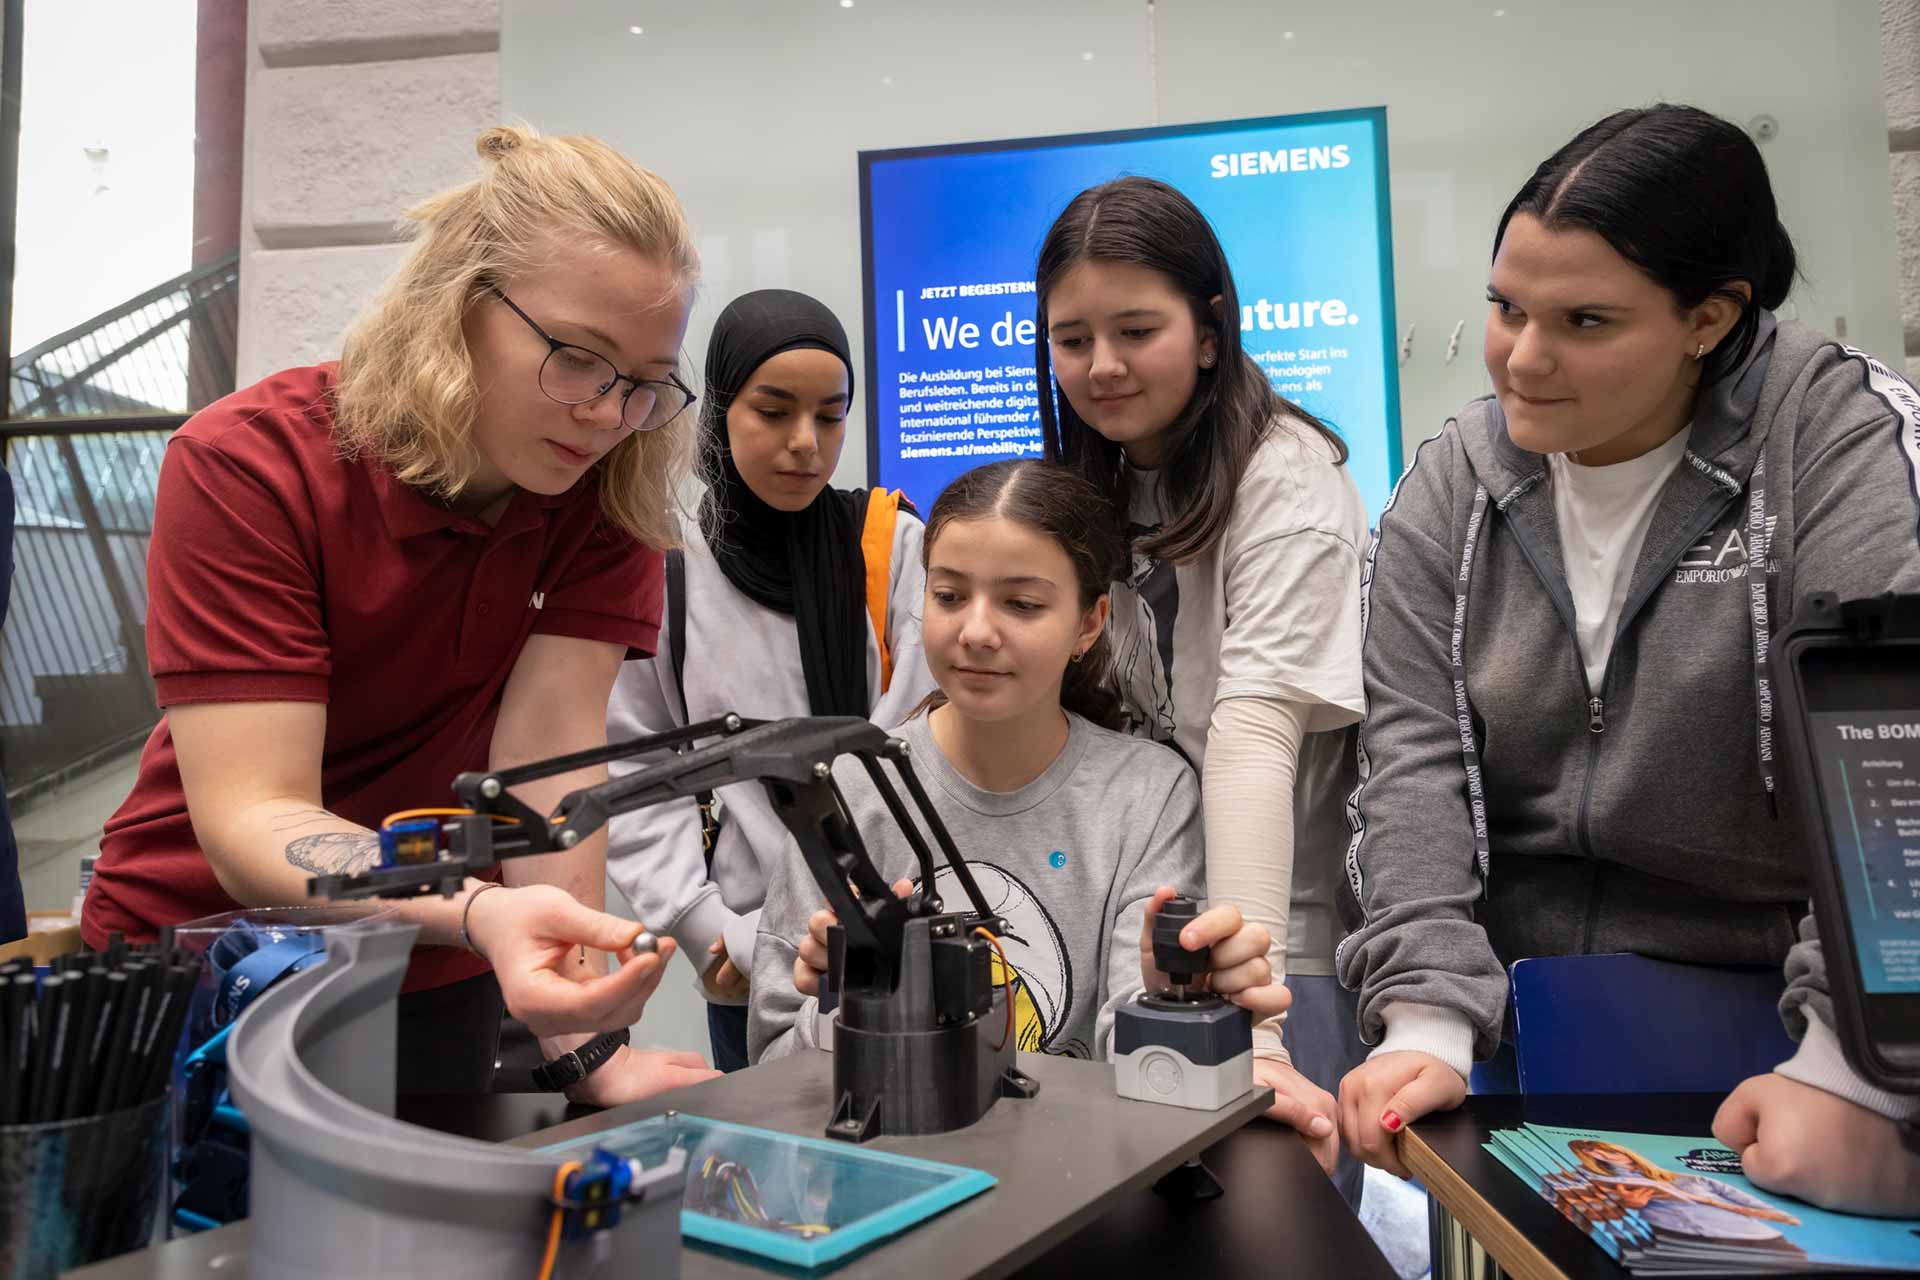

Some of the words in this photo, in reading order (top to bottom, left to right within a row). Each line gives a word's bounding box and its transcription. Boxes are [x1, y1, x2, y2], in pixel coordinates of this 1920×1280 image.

[1210, 144, 1351, 178] SIEMENS
[920, 287, 957, 299] JETZT
[922, 316, 980, 350] We
[899, 372, 918, 384] Die
[920, 368, 983, 382] Ausbildung
[985, 366, 1003, 379] bei
[1249, 350, 1296, 362] erfekte
[1298, 348, 1328, 360] Start
[1330, 347, 1348, 359] ins
[899, 386, 969, 398] Berufsleben.
[971, 382, 1010, 395] Bereits
[1012, 381, 1023, 392] in
[900, 401, 922, 413] und
[924, 397, 1004, 412] weitreichende
[1306, 380, 1323, 392] als
[900, 414, 972, 428] international
[974, 411, 1030, 425] führender
[901, 429, 975, 443] faszinierende
[1750, 489, 1765, 530] EMPORIO
[1459, 543, 1473, 581] EMPORIO
[1466, 512, 1482, 542] ARMANI
[1750, 532, 1765, 568] ARMANI
[1675, 568, 1730, 583] EMPORIO
[1454, 594, 1466, 626] ARMANI
[1751, 583, 1767, 624] EMPORIO
[1452, 628, 1463, 666] EMPORIO
[1755, 628, 1769, 663] ARMANI
[1454, 680, 1468, 712] ARMANI
[1759, 679, 1773, 722] EMPORIO
[1458, 714, 1475, 753] EMPORIO
[1759, 726, 1773, 761] ARMANI
[1836, 725, 1874, 740] The
[1466, 766, 1482, 797] ARMANI
[1472, 800, 1487, 838] EMPORIO
